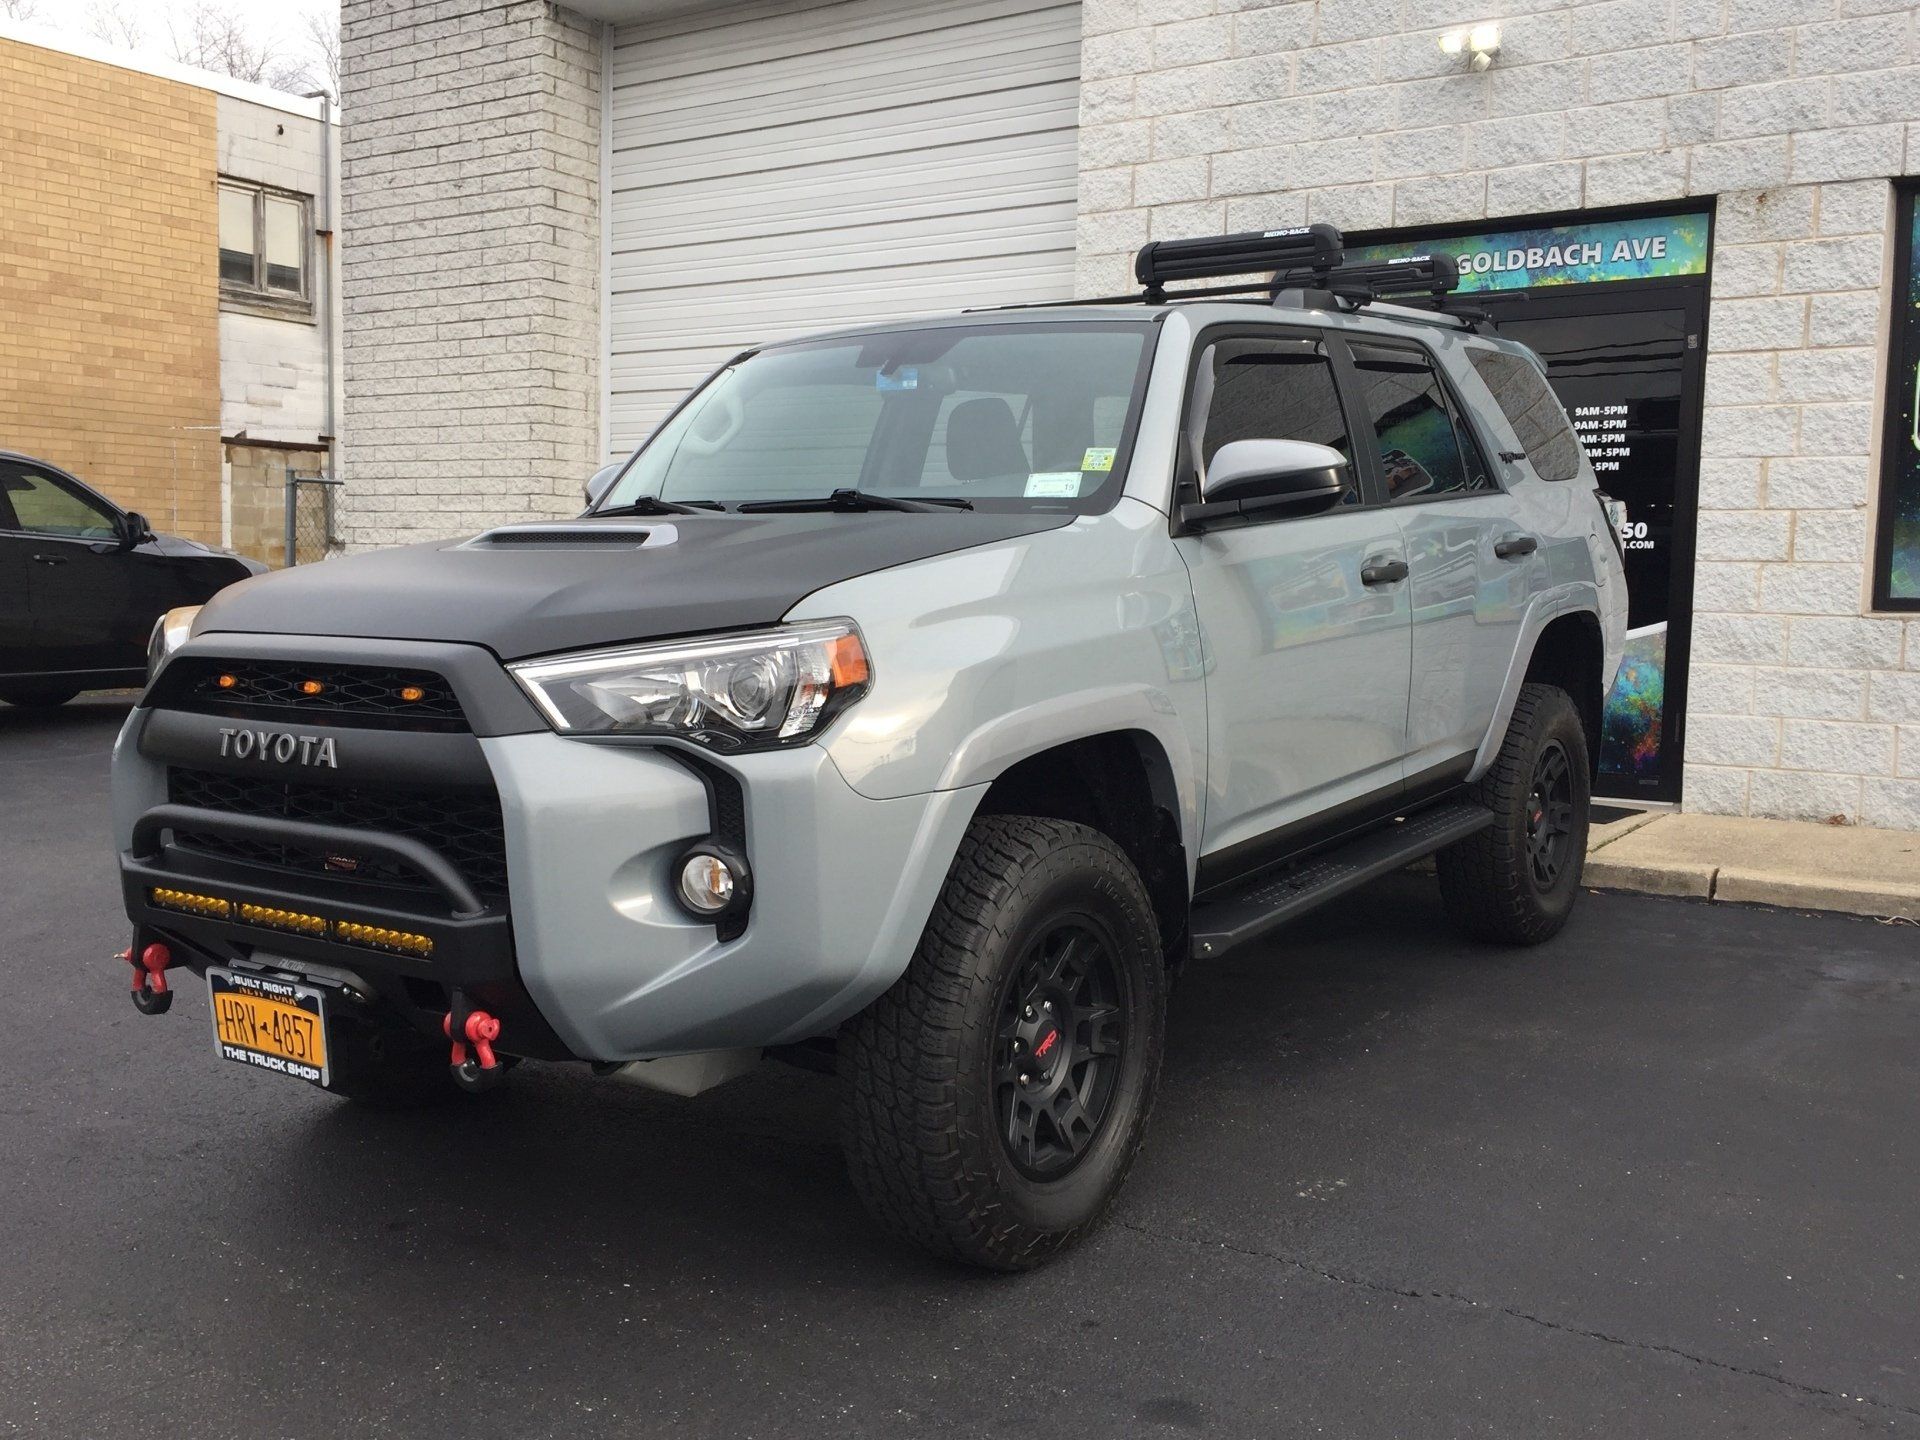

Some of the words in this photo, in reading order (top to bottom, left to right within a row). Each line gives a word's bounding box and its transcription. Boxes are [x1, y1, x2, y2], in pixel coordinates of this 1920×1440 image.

[1456, 243, 1602, 275] GOLDBACH
[1611, 236, 1667, 262] AVE
[1575, 405, 1629, 417] 9AM-5PM
[1573, 419, 1627, 430] 9AM-5PM
[1580, 433, 1626, 444] AM-5PM
[1585, 447, 1631, 457] AM-5PM
[219, 728, 338, 769] TOYOTA
[234, 975, 261, 988] BUILT
[262, 981, 293, 996] RIGHT
[222, 998, 258, 1047] HRV
[273, 1009, 314, 1062] 4857
[223, 1046, 247, 1061] THE
[248, 1052, 286, 1072] TRUCK
[287, 1062, 320, 1081] SHOP
